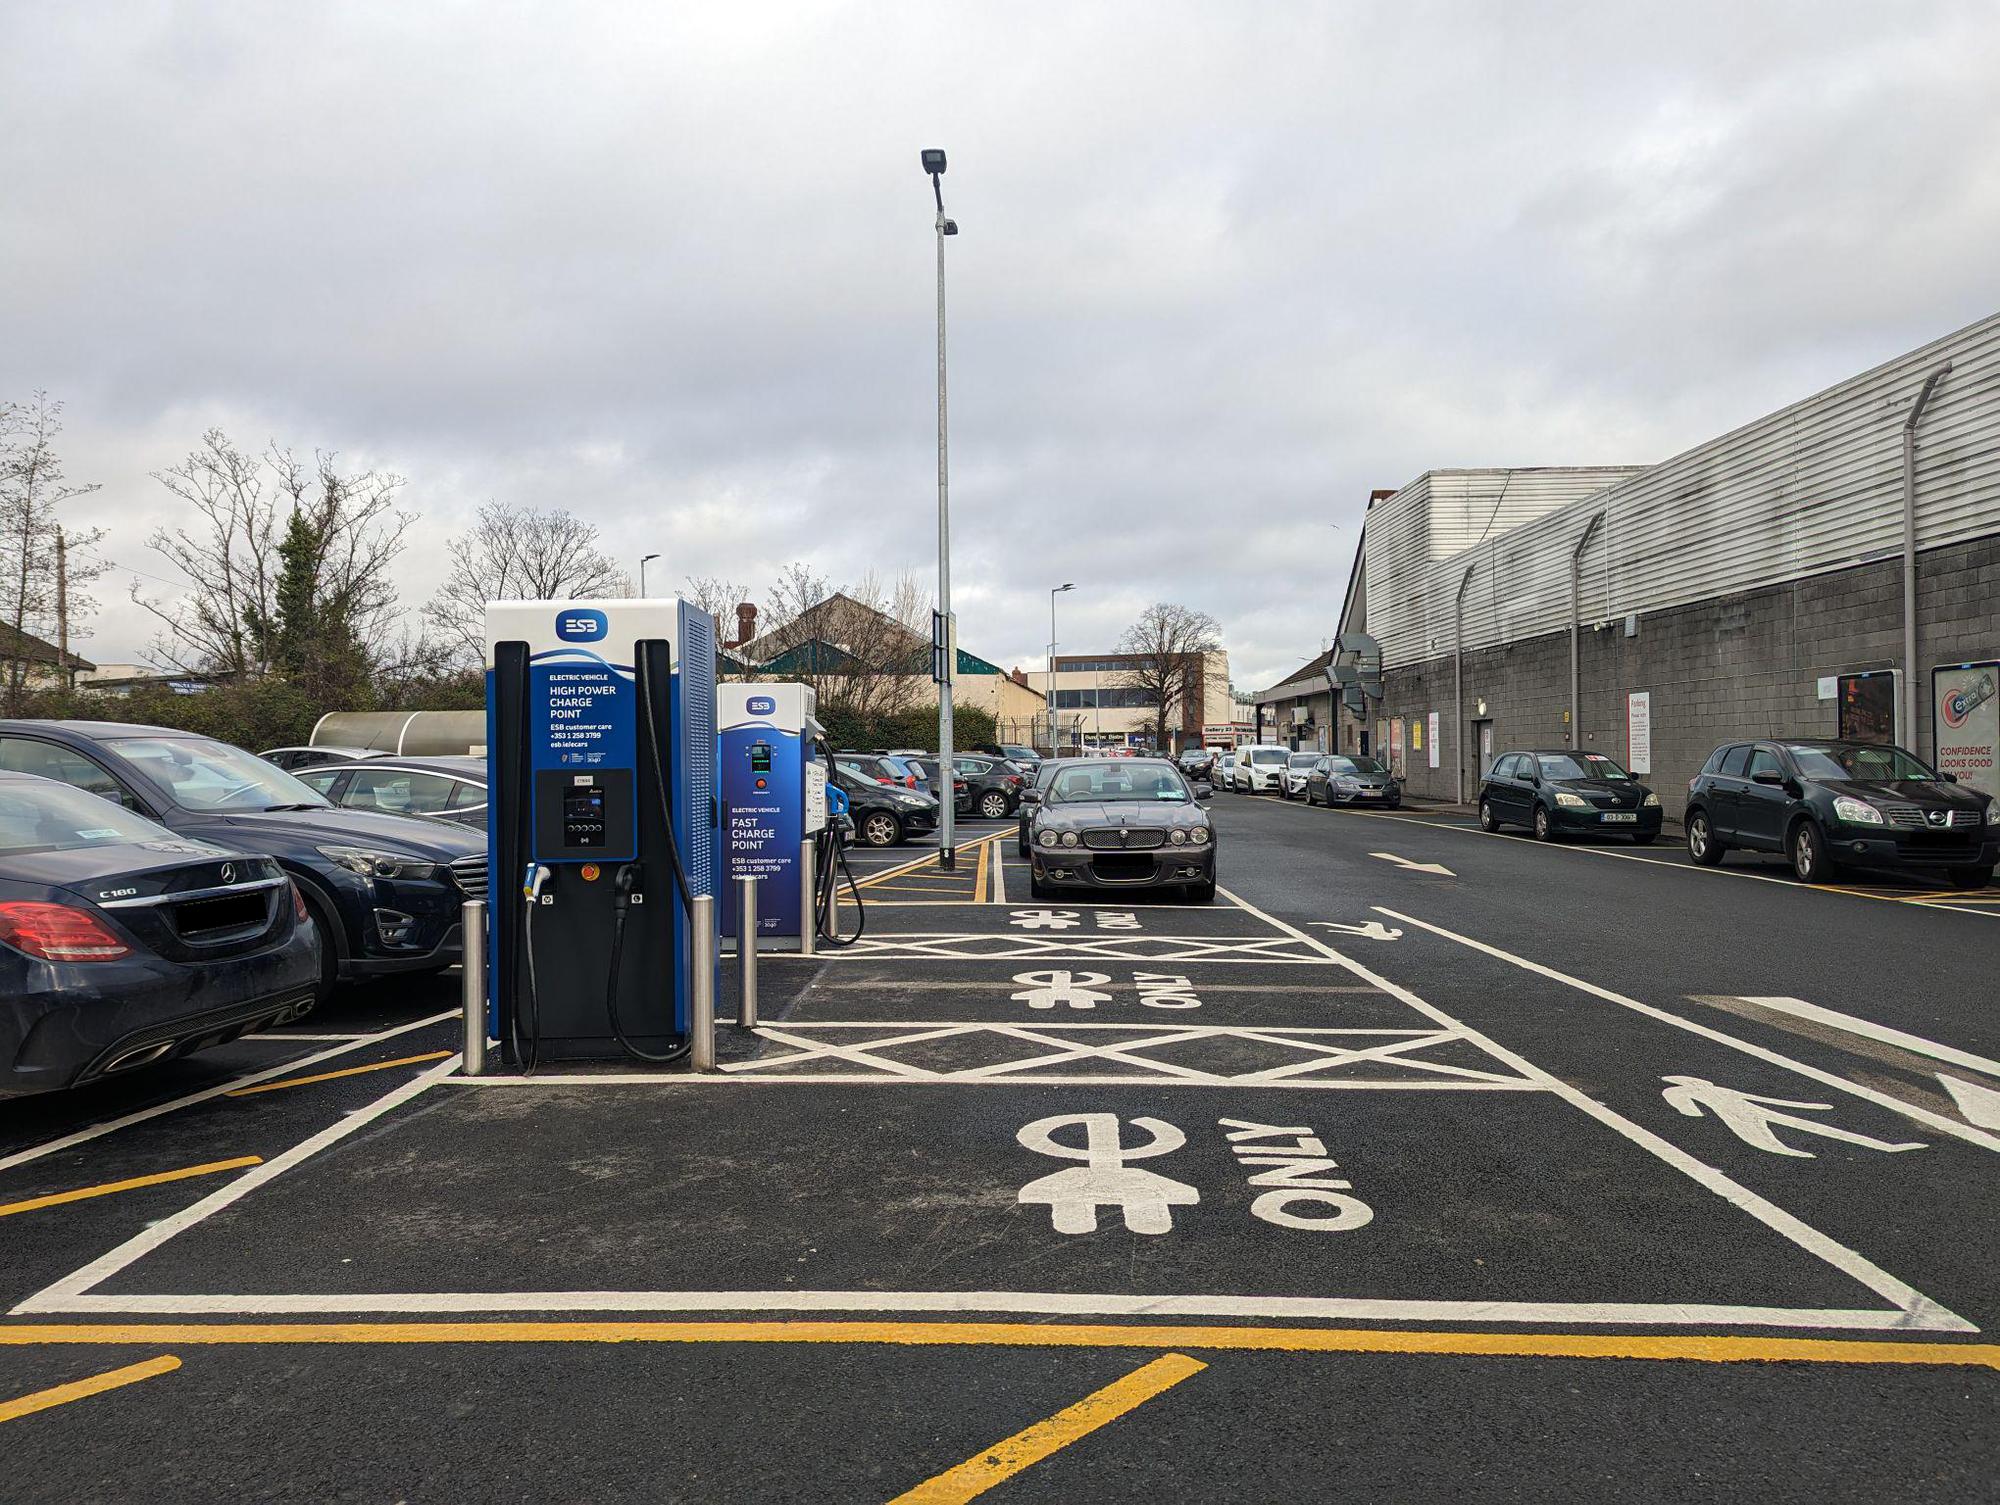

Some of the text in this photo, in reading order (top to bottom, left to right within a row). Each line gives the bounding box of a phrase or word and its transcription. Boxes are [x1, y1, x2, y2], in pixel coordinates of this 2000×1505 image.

[565, 618, 598, 633] ESB
[550, 685, 617, 695] HIGH POWER
[549, 697, 593, 707] CHARGE
[751, 701, 770, 710] ESB
[1955, 692, 1977, 710] extra
[550, 709, 582, 718] POINT
[550, 723, 565, 731] ESB
[1940, 746, 1992, 756] CONFIDENCE
[1940, 759, 1993, 768] LOOKS GOOD
[1954, 770, 1974, 780] YOU!
[731, 818, 758, 828] FAST
[731, 829, 775, 839] CHARGE
[731, 840, 764, 850] POINT
[1132, 971, 1202, 1009] ONLY
[1217, 1117, 1374, 1232] ONLY
